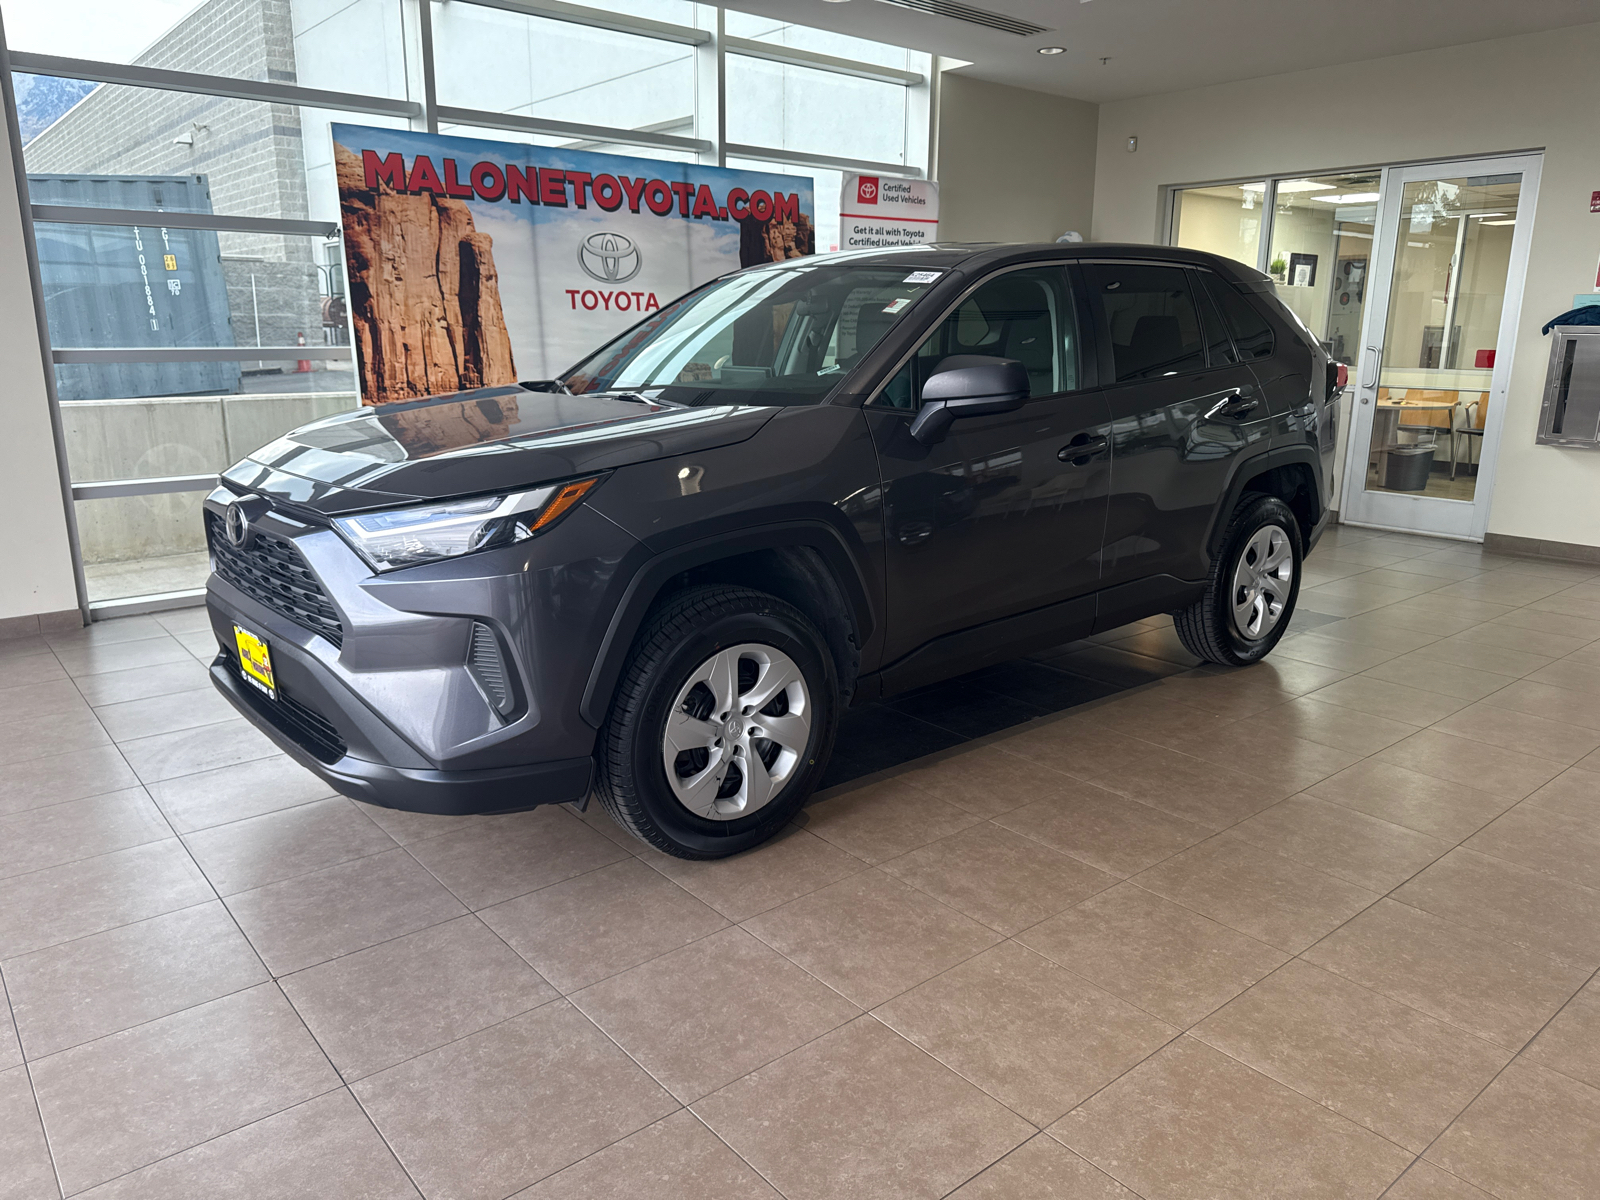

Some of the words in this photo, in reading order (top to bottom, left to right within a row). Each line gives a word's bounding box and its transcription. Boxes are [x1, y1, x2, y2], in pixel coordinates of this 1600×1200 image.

[362, 149, 799, 224] MALONETOYOTA.COM
[883, 183, 911, 193] Certified
[882, 194, 899, 203] Used
[900, 195, 926, 205] Vehicles
[853, 226, 867, 235] Get
[868, 226, 874, 235] it
[875, 227, 884, 235] all
[885, 228, 901, 236] with
[902, 229, 925, 239] Toyota
[848, 237, 880, 246] Certified
[565, 289, 660, 312] TOYOTA
